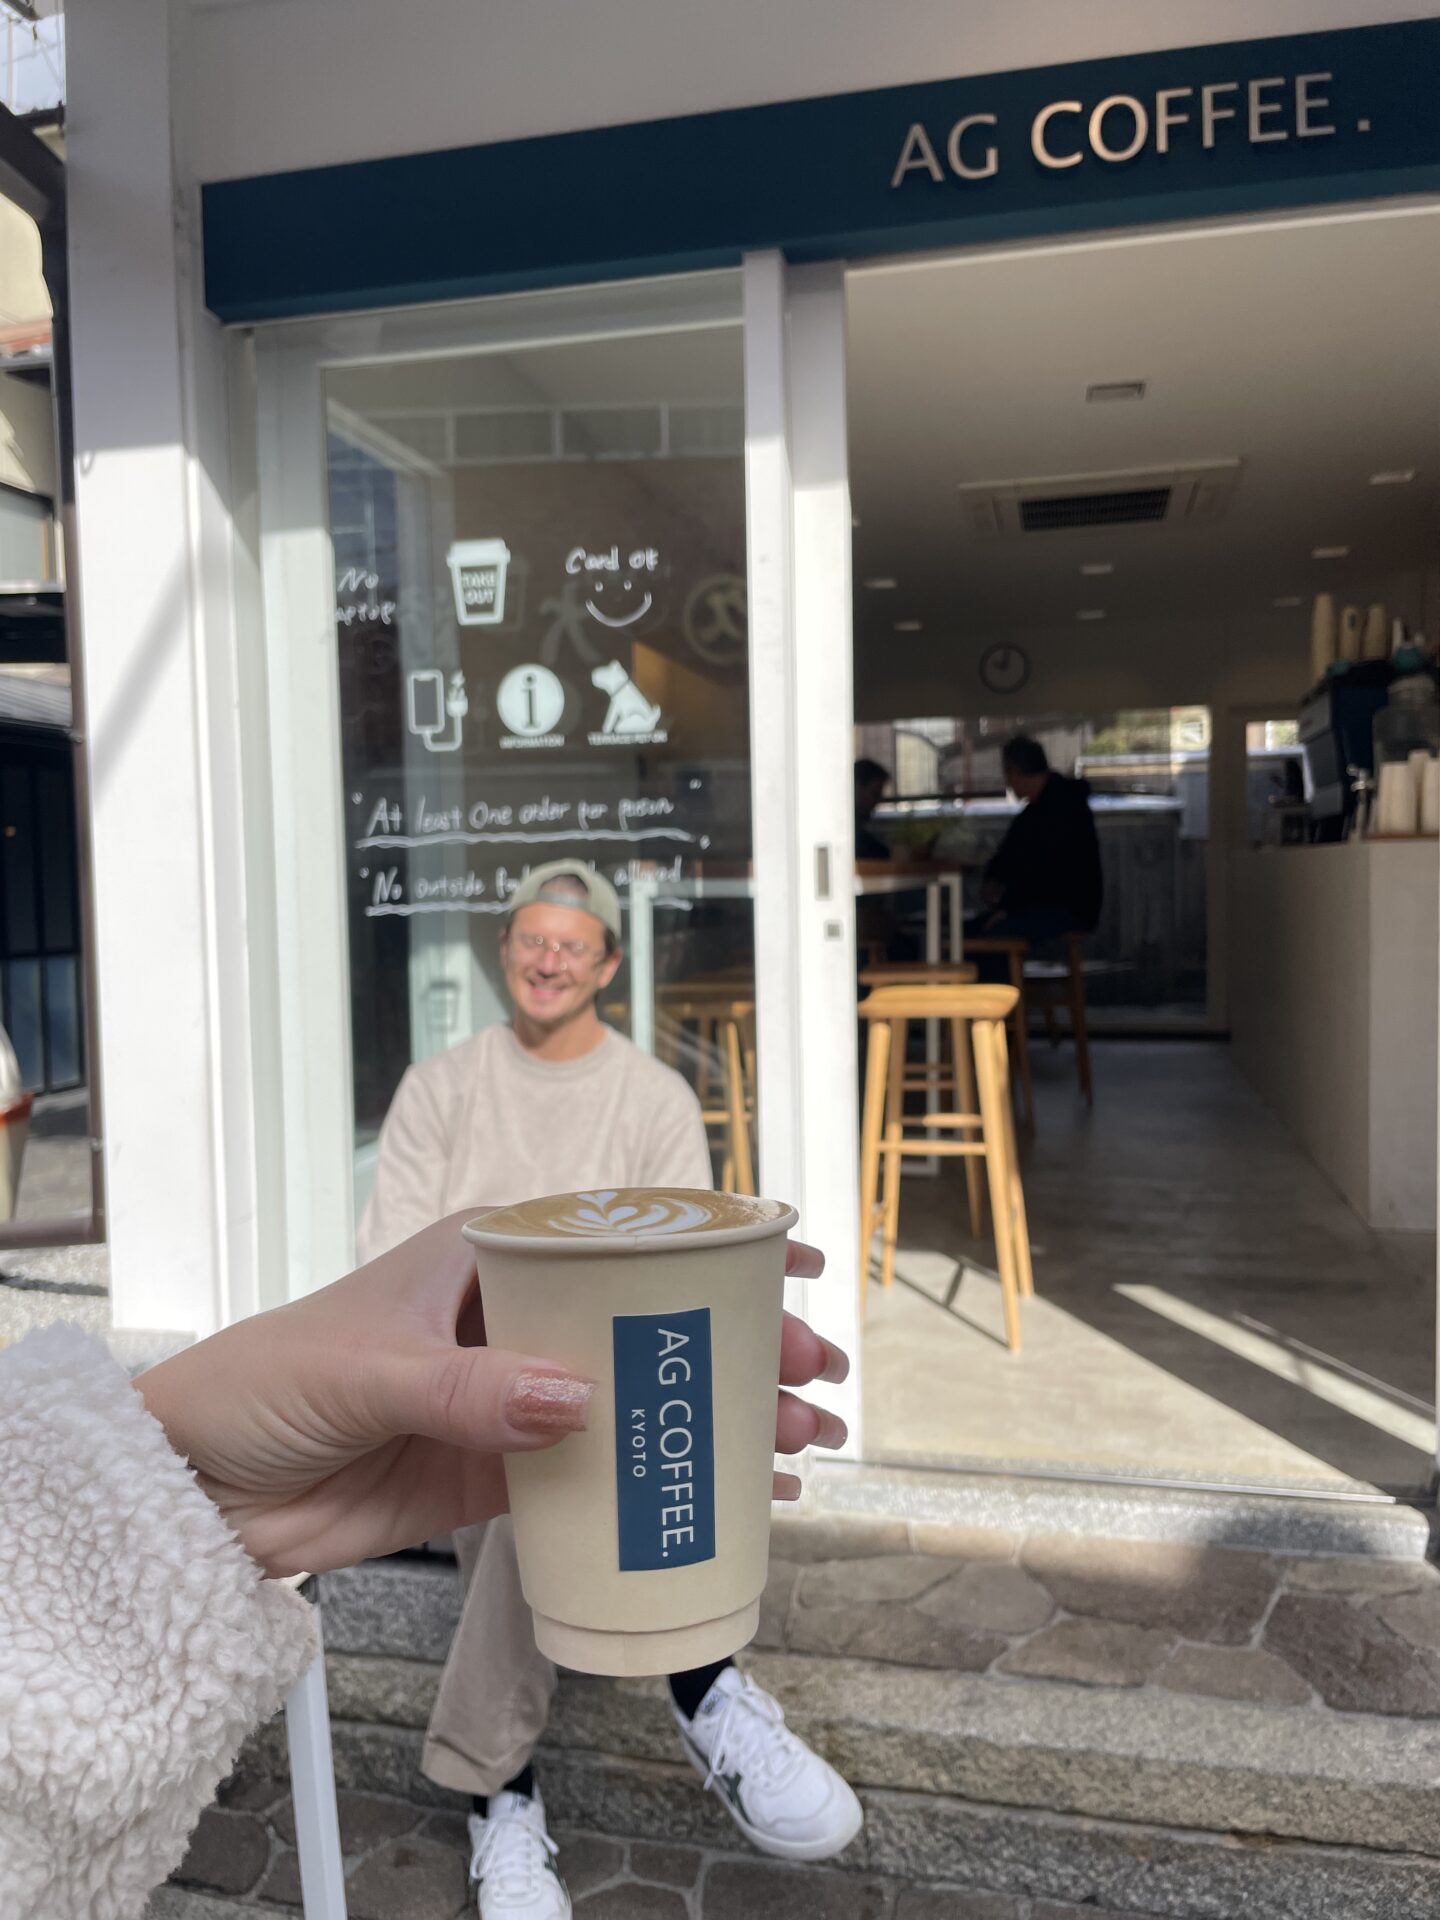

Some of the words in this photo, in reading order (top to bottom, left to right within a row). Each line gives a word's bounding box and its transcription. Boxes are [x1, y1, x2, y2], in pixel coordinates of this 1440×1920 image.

[891, 113, 998, 187] AG
[336, 566, 379, 592] No
[565, 544, 619, 574] Card
[415, 795, 462, 833] least
[469, 801, 513, 829] One
[414, 870, 485, 899] outside
[657, 1328, 691, 1385] AG
[631, 1408, 647, 1478] KYOTO
[659, 1399, 694, 1558] COFFEE.
